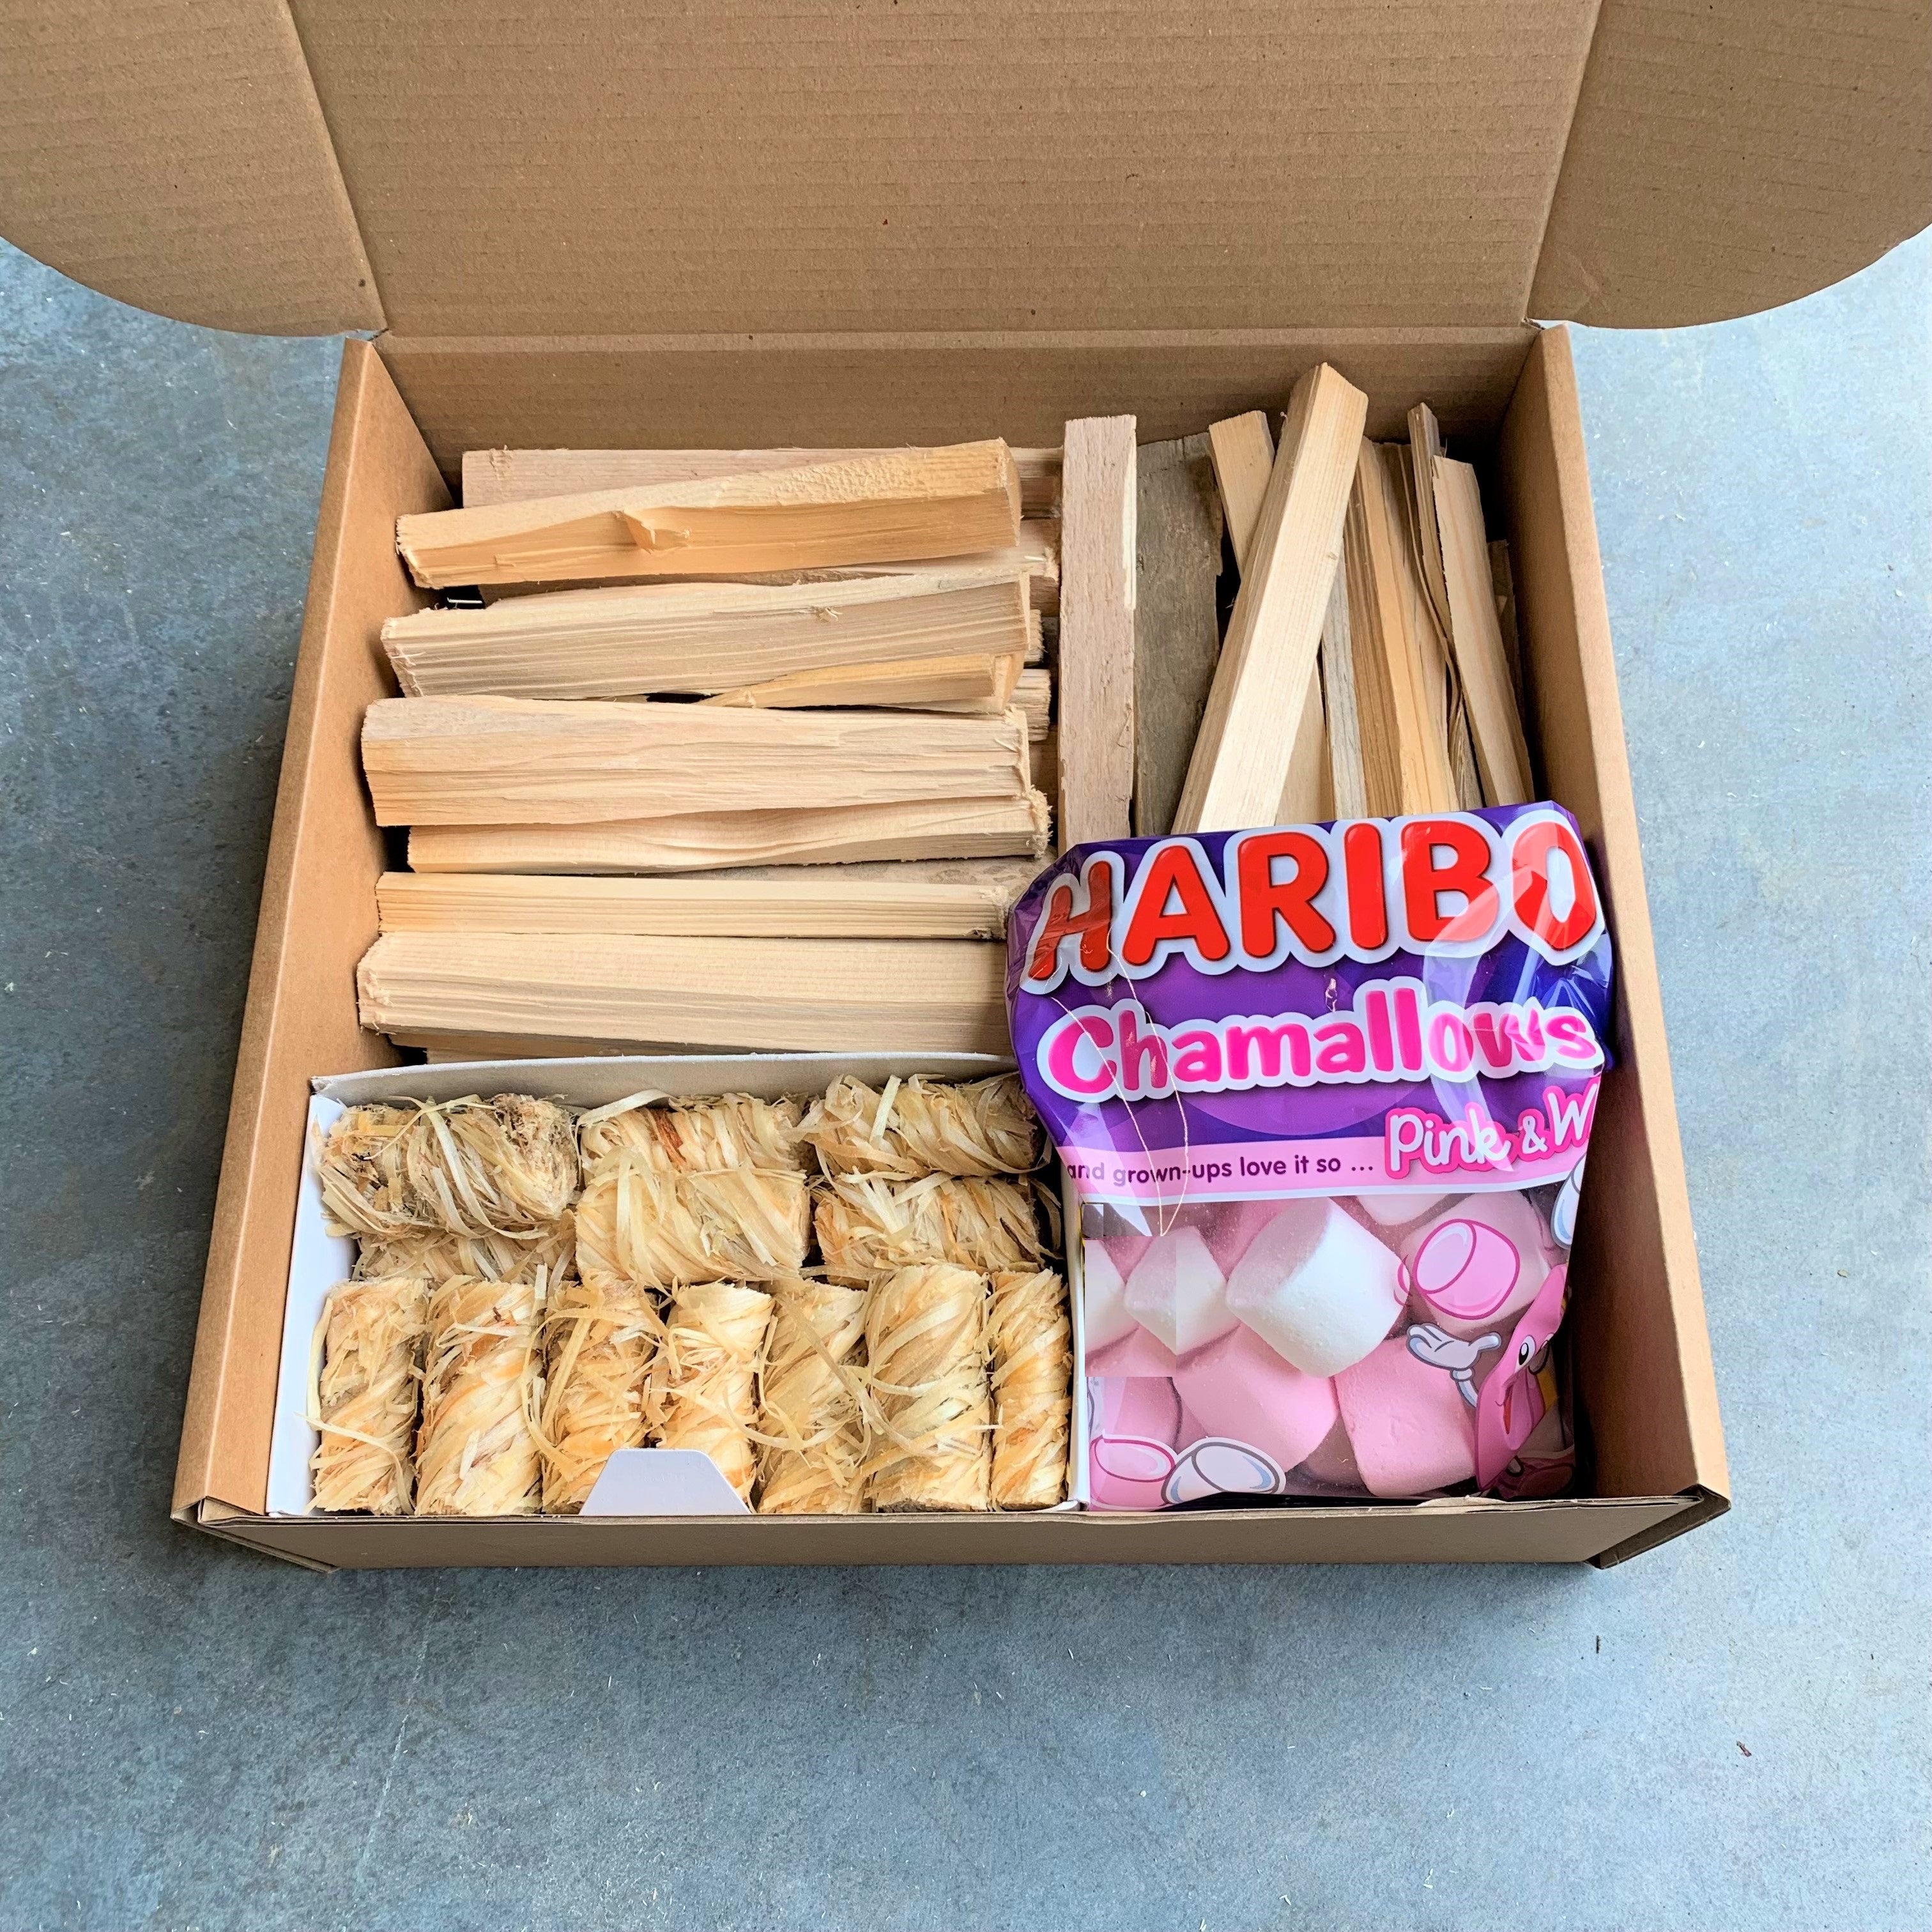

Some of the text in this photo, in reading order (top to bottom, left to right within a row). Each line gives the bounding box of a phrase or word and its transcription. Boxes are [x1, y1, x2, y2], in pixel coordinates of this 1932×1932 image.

[1027, 820, 1596, 981] HARIBO
[1048, 988, 1596, 1094] Chamallows
[1067, 1162, 1105, 1179] and
[1112, 1162, 1232, 1186] grown-ups
[1239, 1156, 1287, 1176] love
[1294, 1154, 1310, 1174] it
[1316, 1157, 1340, 1172] so
[1390, 1108, 1511, 1171] Pink
[1522, 1116, 1547, 1154] &
